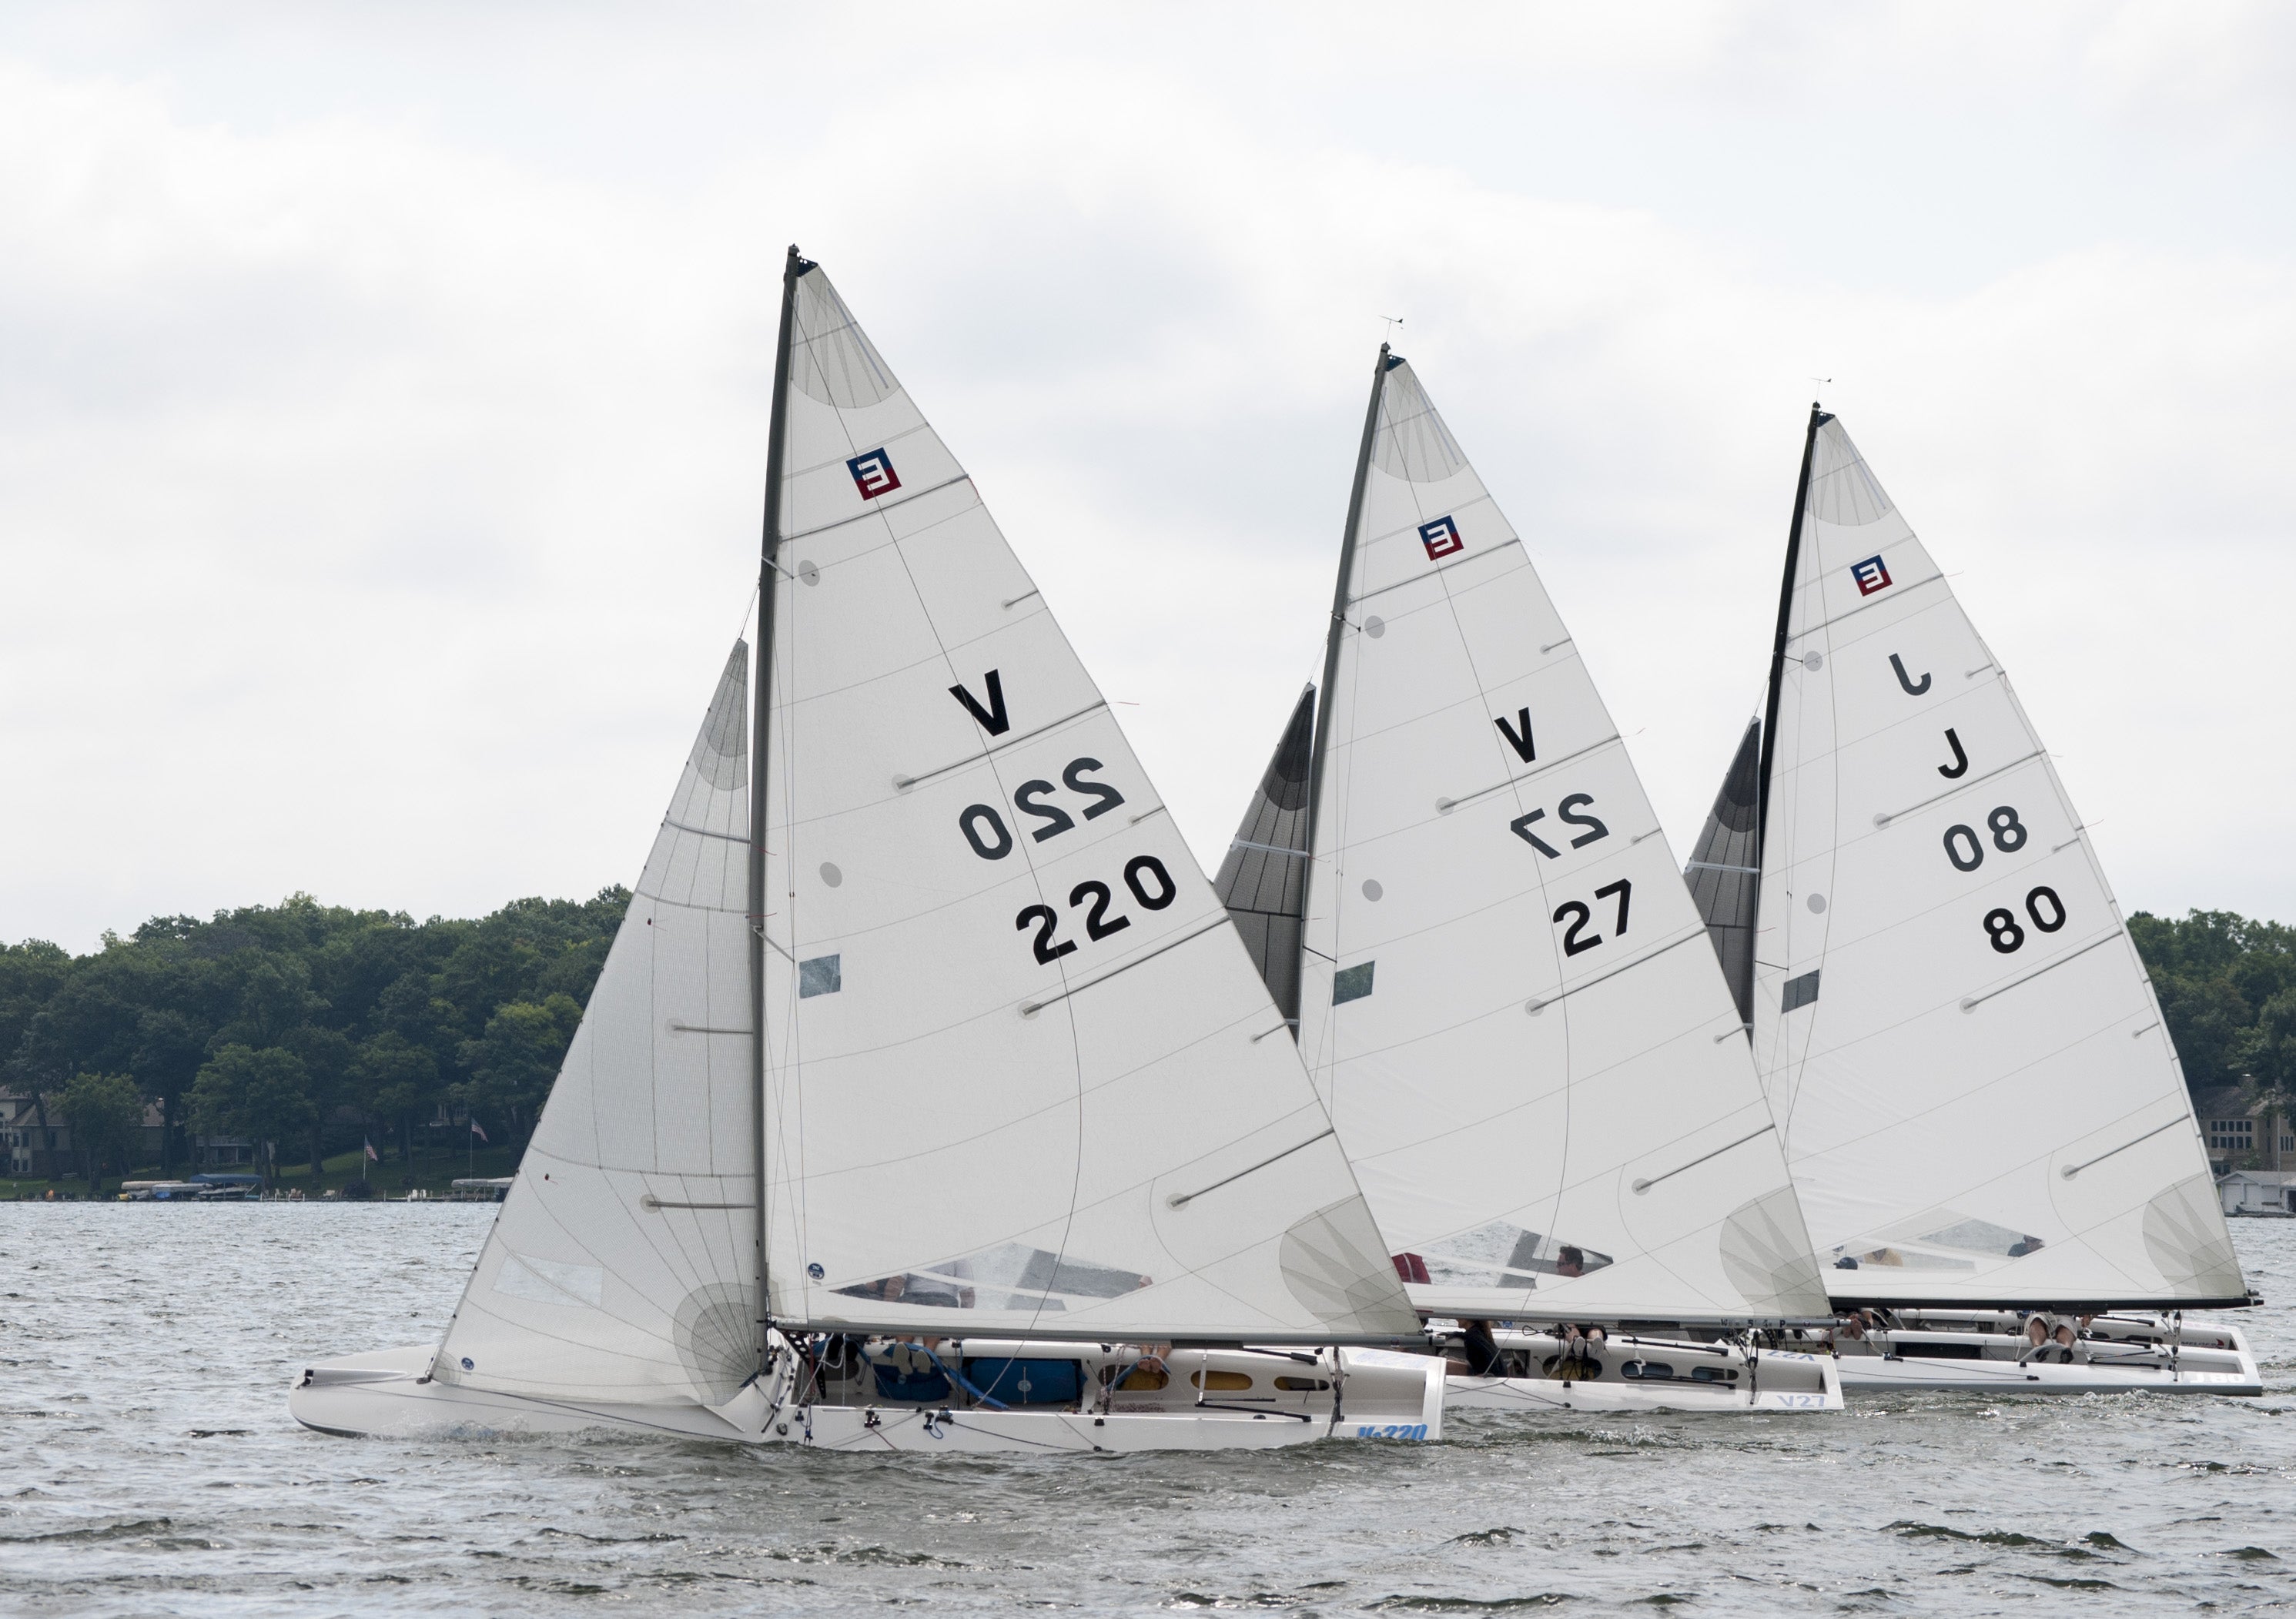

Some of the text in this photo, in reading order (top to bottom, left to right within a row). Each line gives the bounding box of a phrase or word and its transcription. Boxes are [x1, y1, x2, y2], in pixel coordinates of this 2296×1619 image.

[948, 668, 1010, 737] V
[1494, 707, 1536, 764] V
[1937, 728, 1969, 779] J
[1016, 855, 1176, 966] 220
[1552, 878, 1632, 958] 27
[1983, 885, 2067, 954] 80
[1776, 1395, 1825, 1407] V27
[2209, 1373, 2246, 1383] 80
